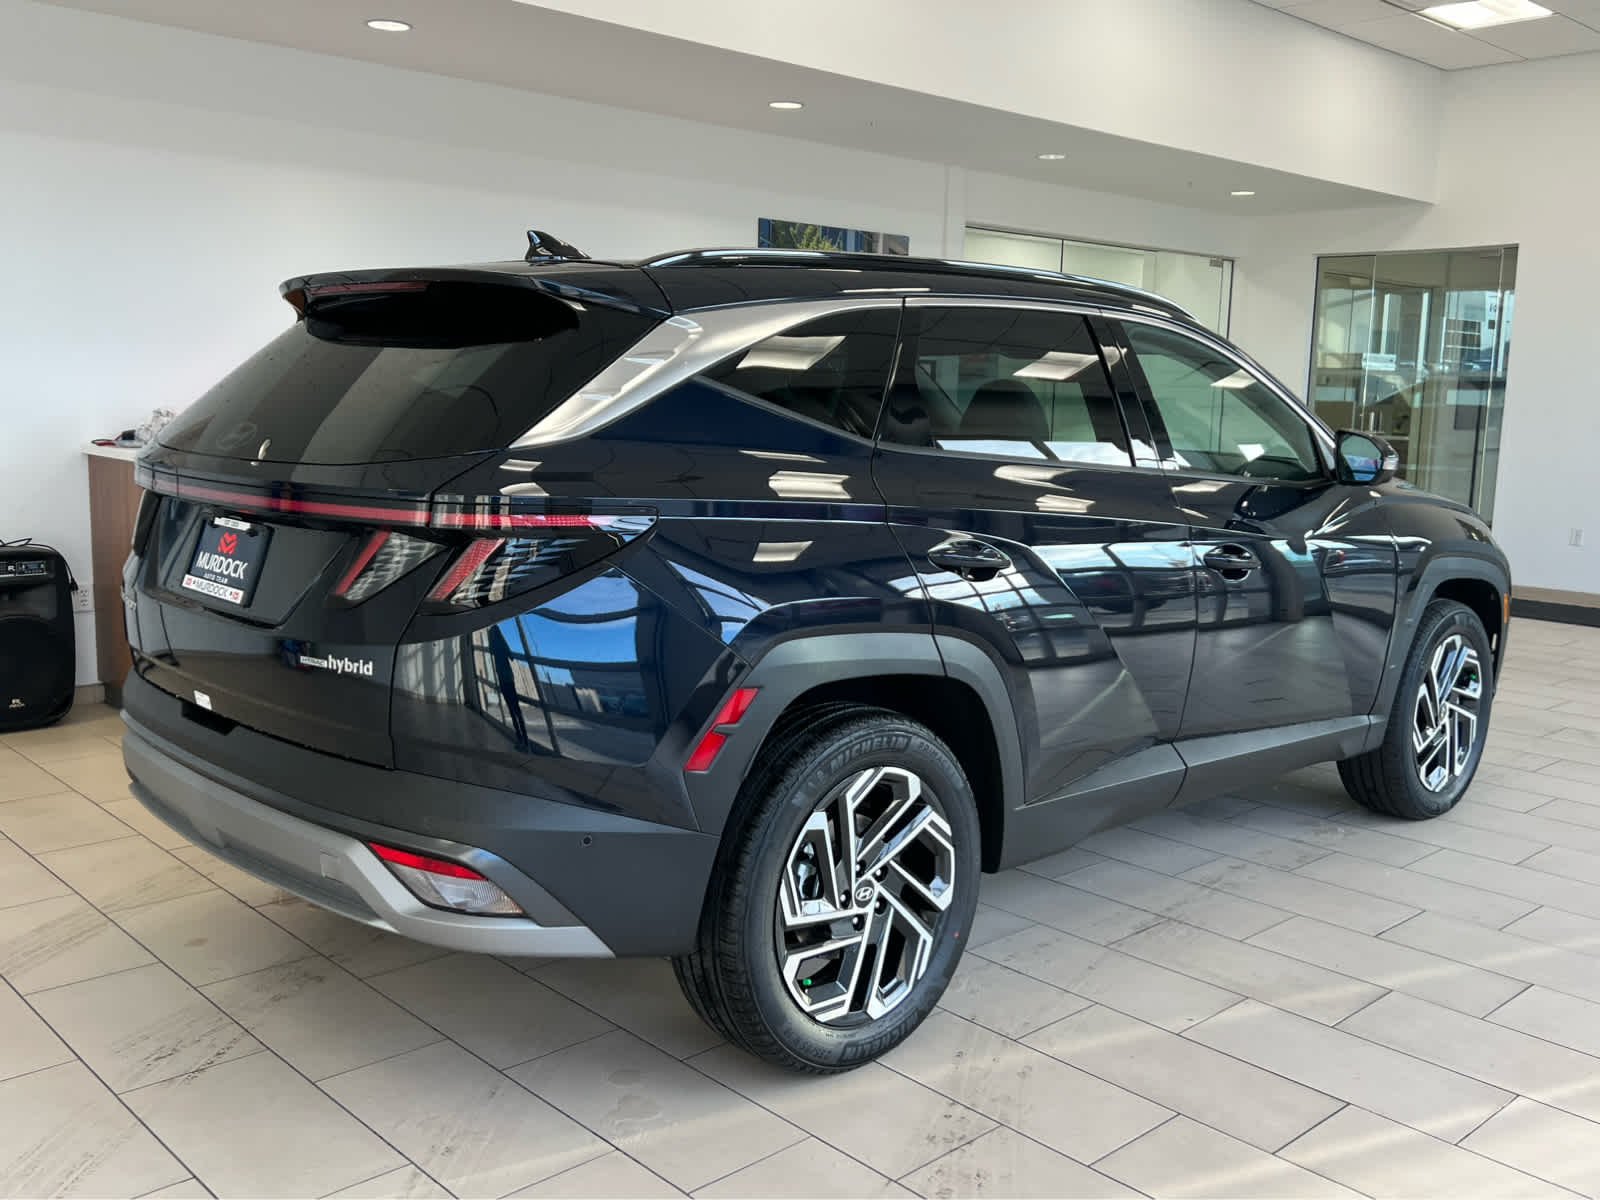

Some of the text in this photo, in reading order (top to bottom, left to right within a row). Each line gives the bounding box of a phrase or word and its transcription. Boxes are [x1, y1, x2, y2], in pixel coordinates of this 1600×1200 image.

[195, 551, 248, 580] MURDOCK
[327, 653, 374, 677] hybrid
[830, 735, 911, 772] MICHELIN
